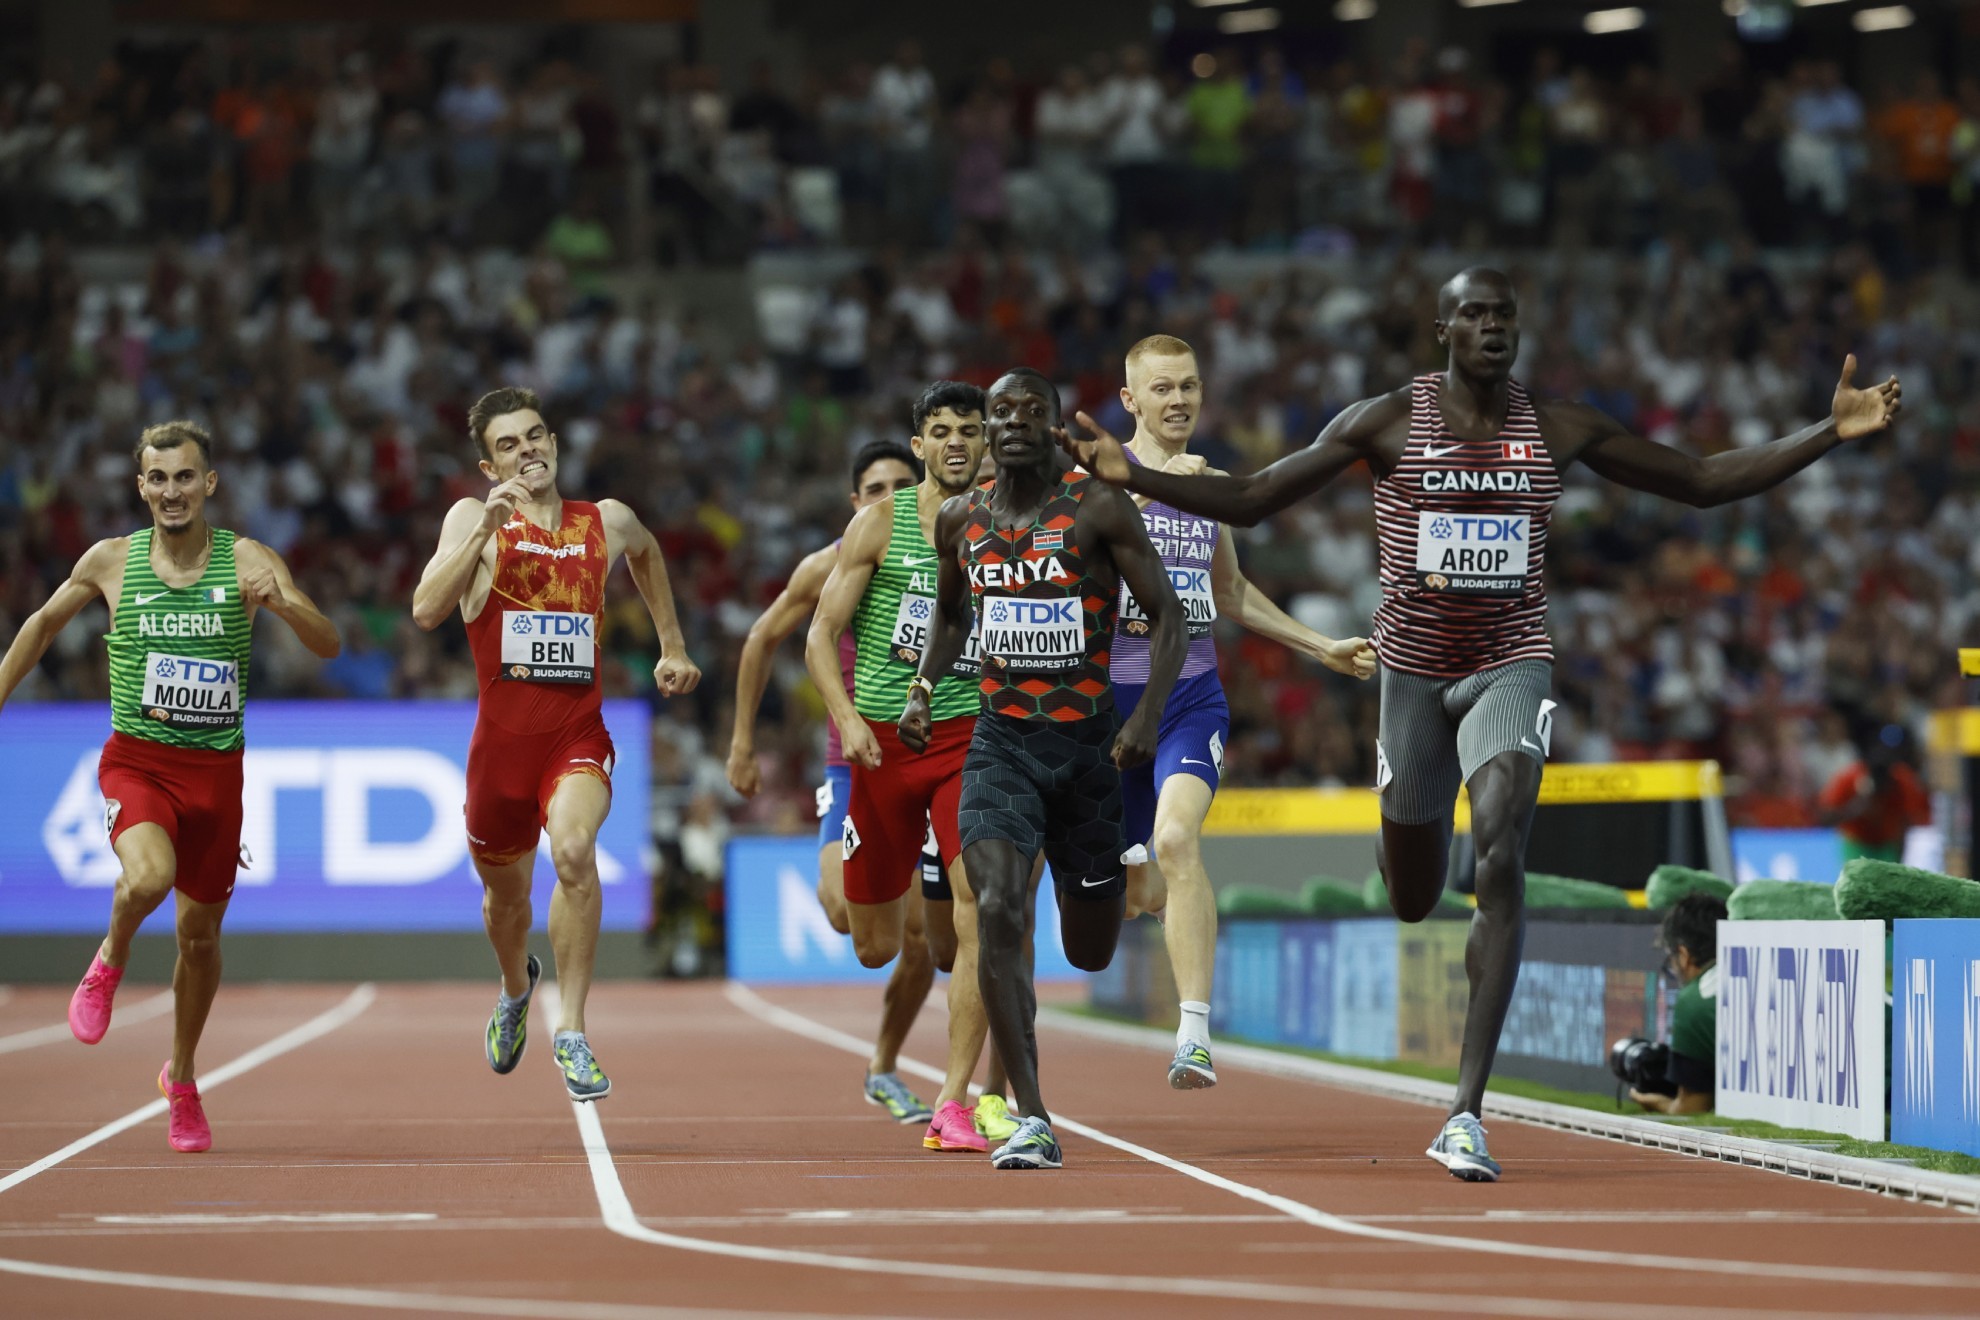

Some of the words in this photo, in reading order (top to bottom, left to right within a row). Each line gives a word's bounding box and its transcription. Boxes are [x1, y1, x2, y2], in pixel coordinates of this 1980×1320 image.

[1422, 470, 1531, 492] CANADA
[1453, 518, 1525, 541] TDK
[1149, 537, 1215, 563] RITAIN
[1439, 548, 1509, 572] AROP
[967, 556, 1068, 588] KENYA
[1451, 578, 1510, 589] BUDAPEST
[1510, 579, 1522, 588] 23
[1008, 601, 1077, 624] TDK
[138, 613, 225, 638] ALGERIA
[532, 615, 590, 637] TDK
[531, 641, 574, 663] BEN
[985, 629, 1080, 653] WANYONYI
[177, 659, 237, 685] TDK
[533, 668, 584, 679] BUDAPEST
[583, 671, 592, 680] 23
[1010, 658, 1068, 669] BUDAPEST
[1067, 657, 1080, 667] 23
[154, 684, 232, 710] MOULA
[172, 712, 224, 724] BUDAPEST
[223, 715, 235, 724] 23
[1826, 948, 1859, 1109] TDK
[1905, 957, 1935, 1119] NTN
